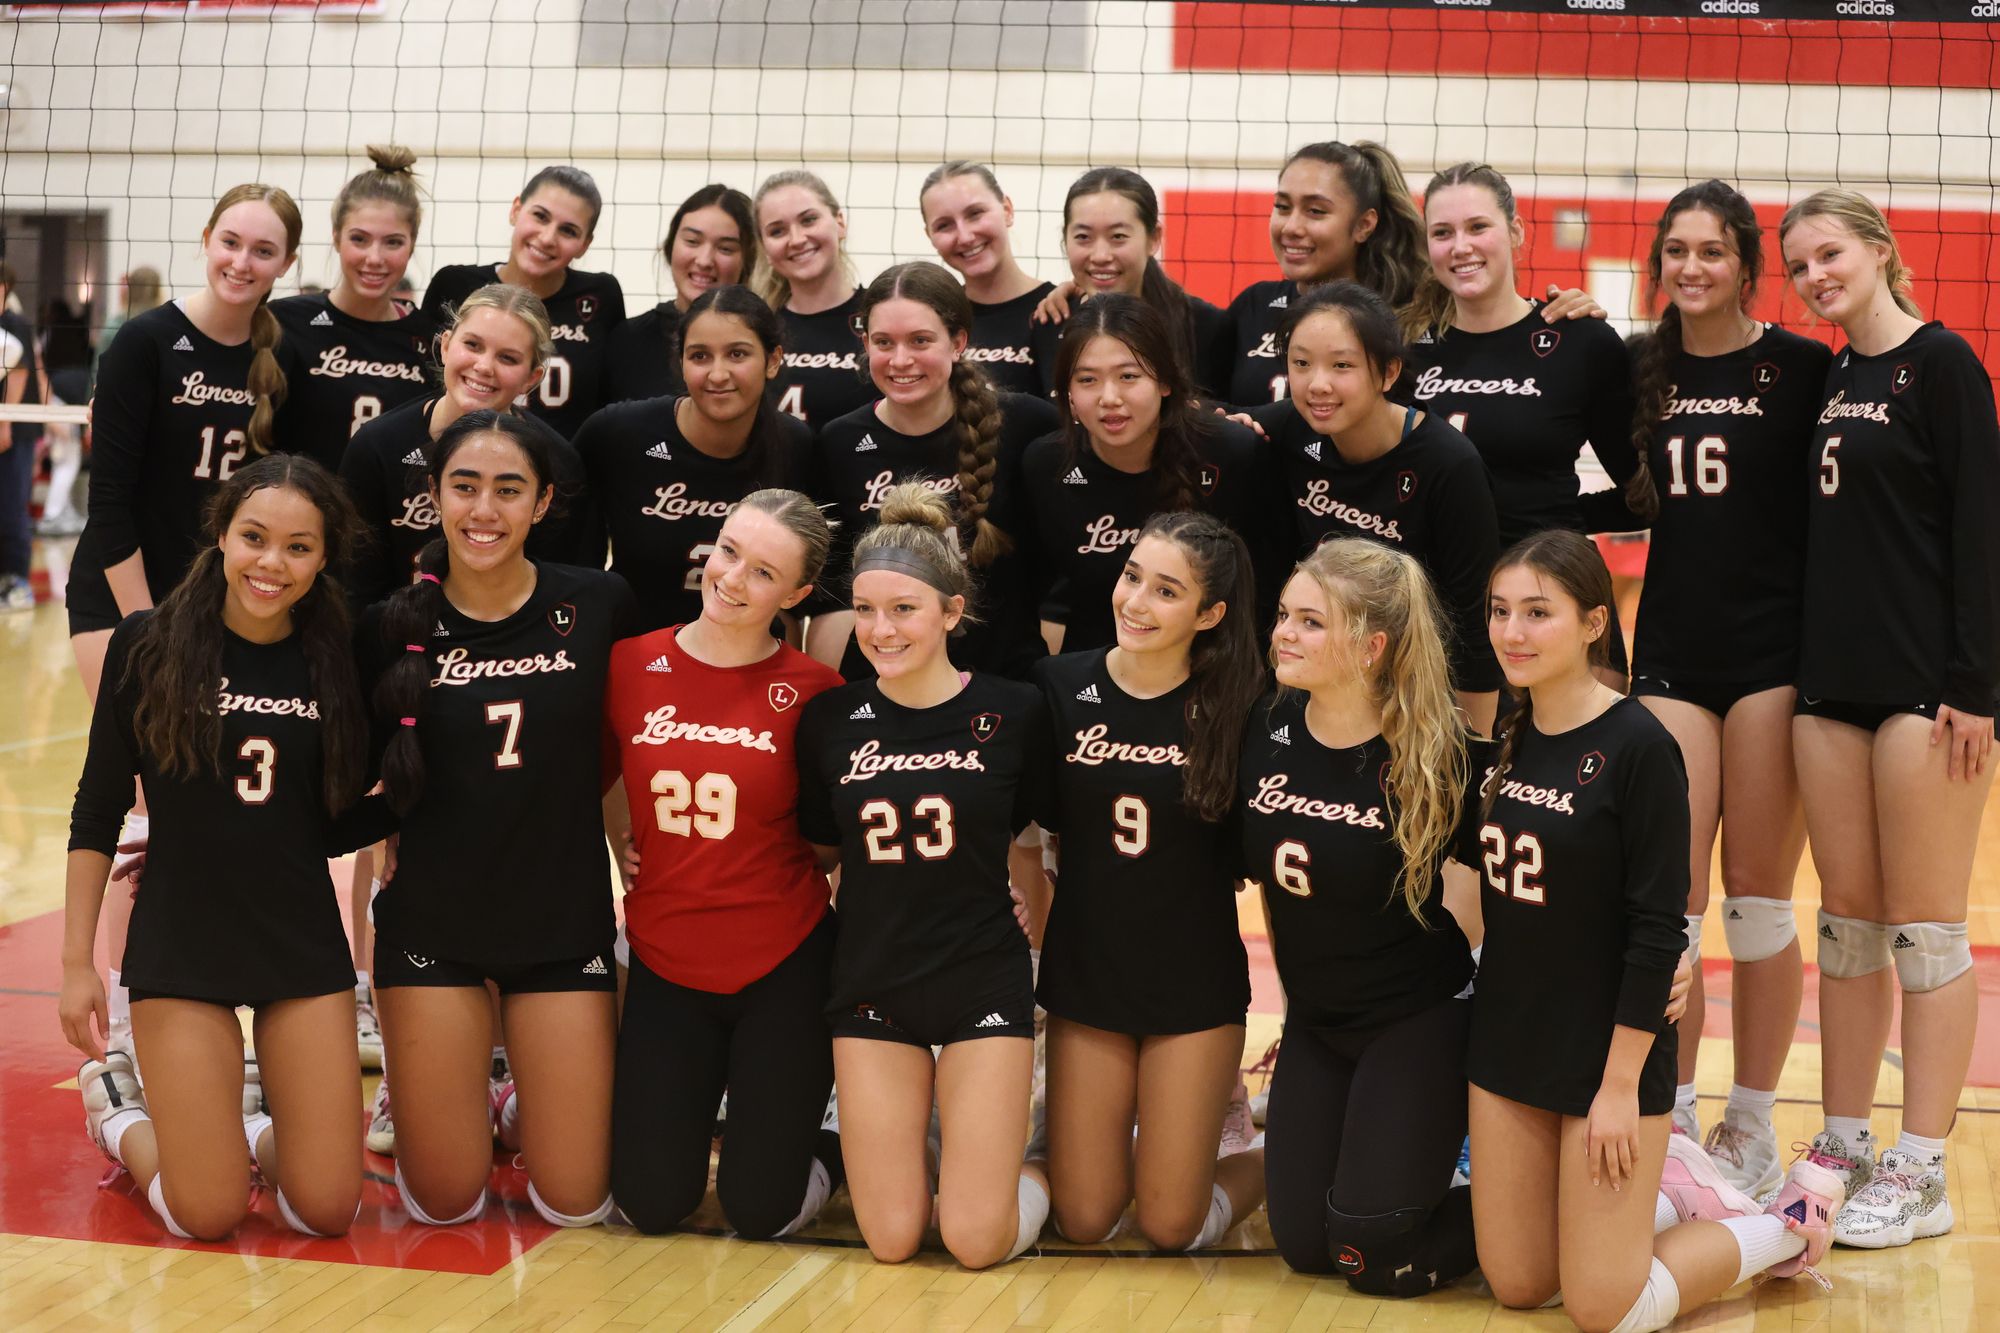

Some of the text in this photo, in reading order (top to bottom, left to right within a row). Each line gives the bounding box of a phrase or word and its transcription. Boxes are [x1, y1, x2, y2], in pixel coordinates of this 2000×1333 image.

[1567, 0, 1626, 10] adidas
[1701, 0, 1760, 14] adidas
[1836, 1, 1895, 16] adidas
[582, 300, 592, 313] L
[1538, 335, 1551, 348] L
[309, 345, 425, 384] Lancers
[781, 352, 860, 371] ncers
[962, 346, 1034, 365] ncers
[1413, 365, 1542, 400] Lancers
[1758, 368, 1771, 383] L
[1896, 369, 1908, 385] L
[171, 370, 256, 406] Lancer
[777, 384, 807, 421] 4
[1817, 389, 1890, 425] Lancers
[193, 425, 248, 481] 12
[645, 449, 672, 461] adidas
[855, 443, 878, 452] adidas
[1304, 446, 1321, 462] adidas
[1665, 434, 1729, 497] 16
[1820, 434, 1843, 497] 5
[1063, 476, 1088, 485] adidas
[1201, 471, 1212, 485] L
[1401, 477, 1411, 493] L
[1297, 479, 1403, 541] Lancers
[555, 610, 569, 625] L
[430, 648, 576, 687] Lancers
[645, 663, 672, 673] adidas
[775, 688, 788, 704] L
[1076, 692, 1102, 704] adidas
[849, 711, 876, 720] adidas
[978, 717, 991, 731] L
[484, 699, 524, 770] 7
[631, 704, 777, 754] Lancers
[1066, 723, 1190, 766] Lancer
[1270, 733, 1291, 746] adidas
[235, 736, 278, 805] 3
[840, 739, 985, 785] Lancers
[1582, 758, 1595, 774] L
[1479, 763, 1574, 816] Lncers
[650, 769, 738, 840] 29
[1248, 773, 1385, 830] Lancers
[858, 793, 956, 864] 23
[1112, 793, 1151, 858] 9
[1272, 837, 1314, 898] 6
[1479, 822, 1547, 906] 22
[582, 966, 608, 975] adidas
